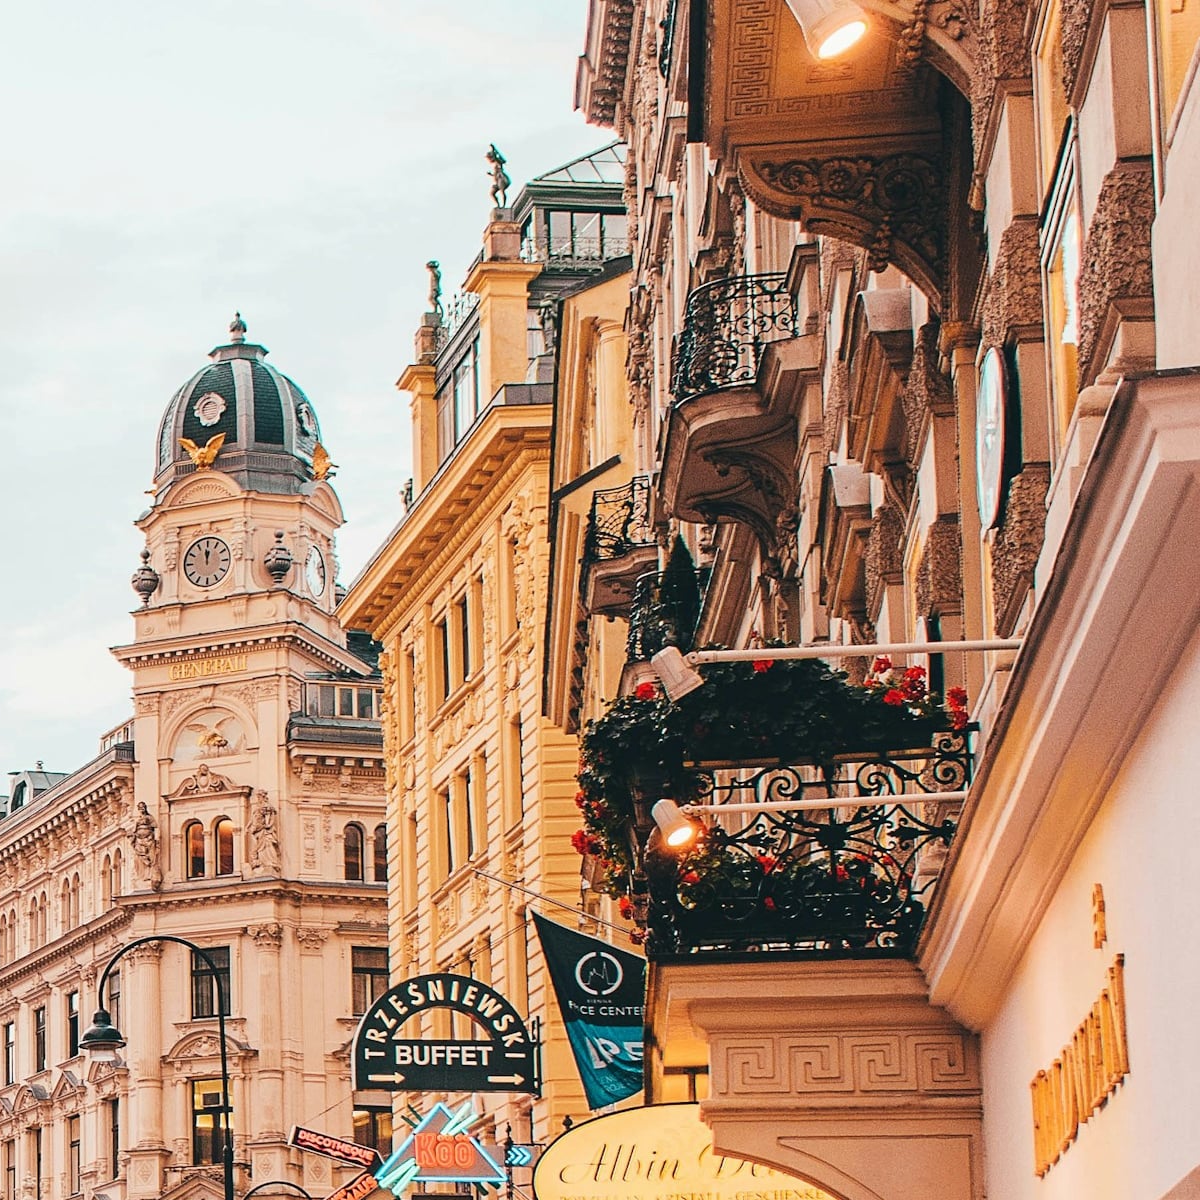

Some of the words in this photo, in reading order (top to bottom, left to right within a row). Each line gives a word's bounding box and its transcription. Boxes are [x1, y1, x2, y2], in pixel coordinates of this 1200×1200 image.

[169, 655, 247, 680] GENERALI
[395, 1045, 494, 1066] BUFFET
[298, 1130, 375, 1161] DISCOTHEQUE
[559, 1143, 683, 1185] Albin
